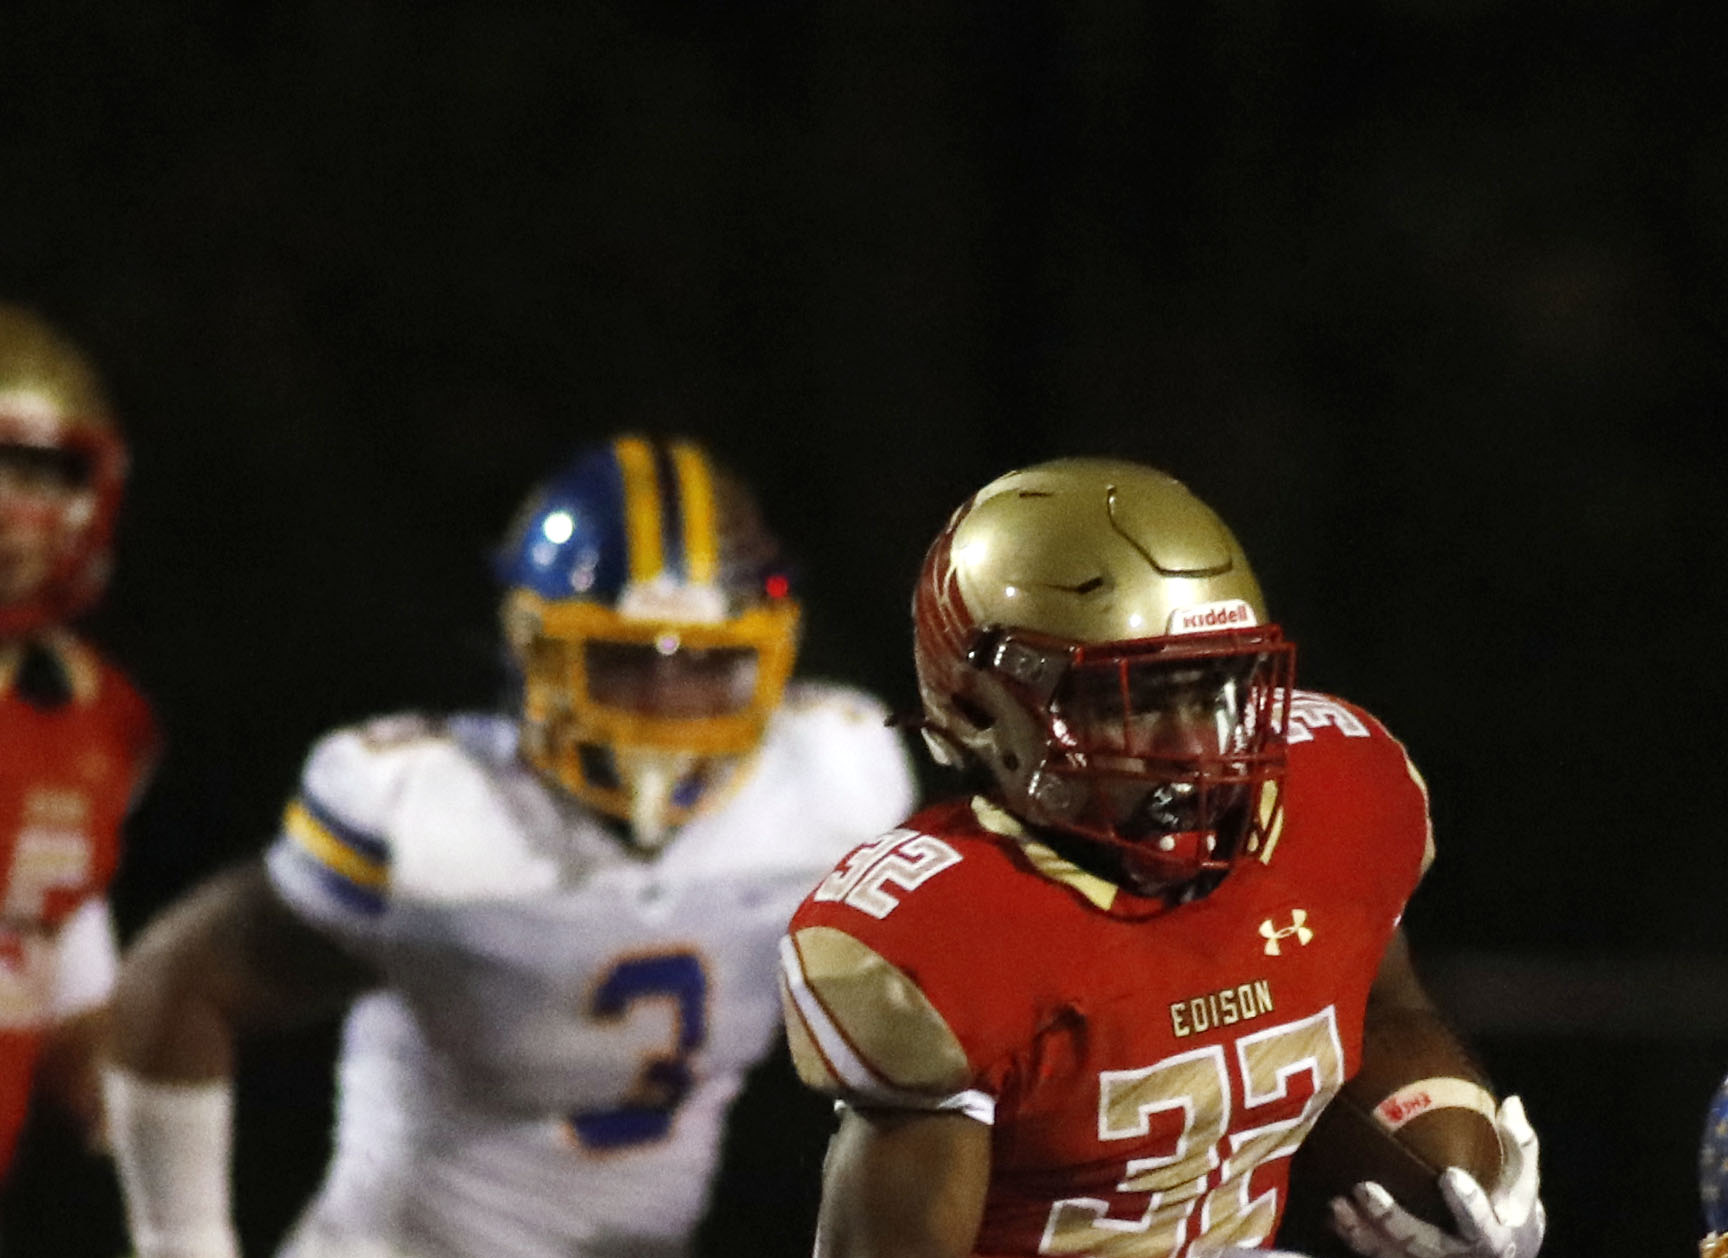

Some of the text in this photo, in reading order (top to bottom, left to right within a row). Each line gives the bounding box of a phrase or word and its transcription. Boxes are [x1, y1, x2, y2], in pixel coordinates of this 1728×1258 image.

[1183, 604, 1248, 629] Riddell
[814, 828, 964, 920] 32
[1168, 978, 1275, 1038] EDISON
[562, 942, 712, 1160] 3
